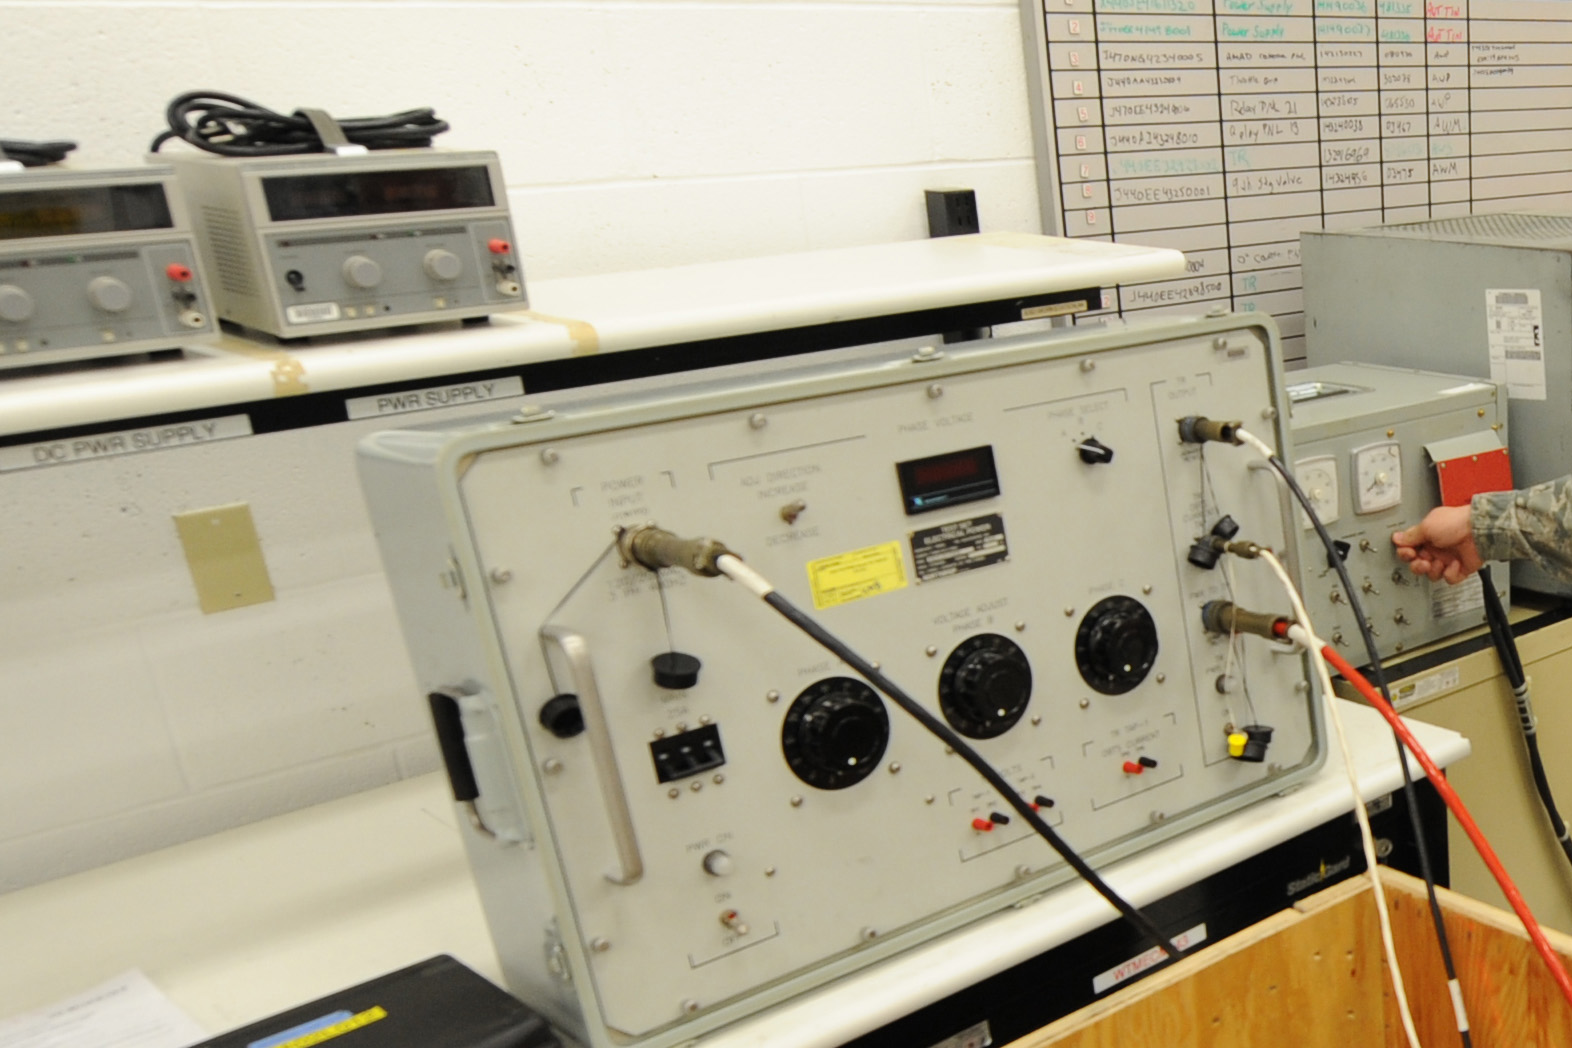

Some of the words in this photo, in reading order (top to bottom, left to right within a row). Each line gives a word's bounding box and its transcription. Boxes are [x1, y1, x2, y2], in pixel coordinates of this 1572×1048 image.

[1432, 161, 1458, 175] AWM
[376, 389, 422, 416] PWR
[424, 381, 497, 409] SUPPLY
[32, 440, 68, 465] DC
[74, 429, 125, 460] PWR
[127, 419, 218, 453] SUPPLY
